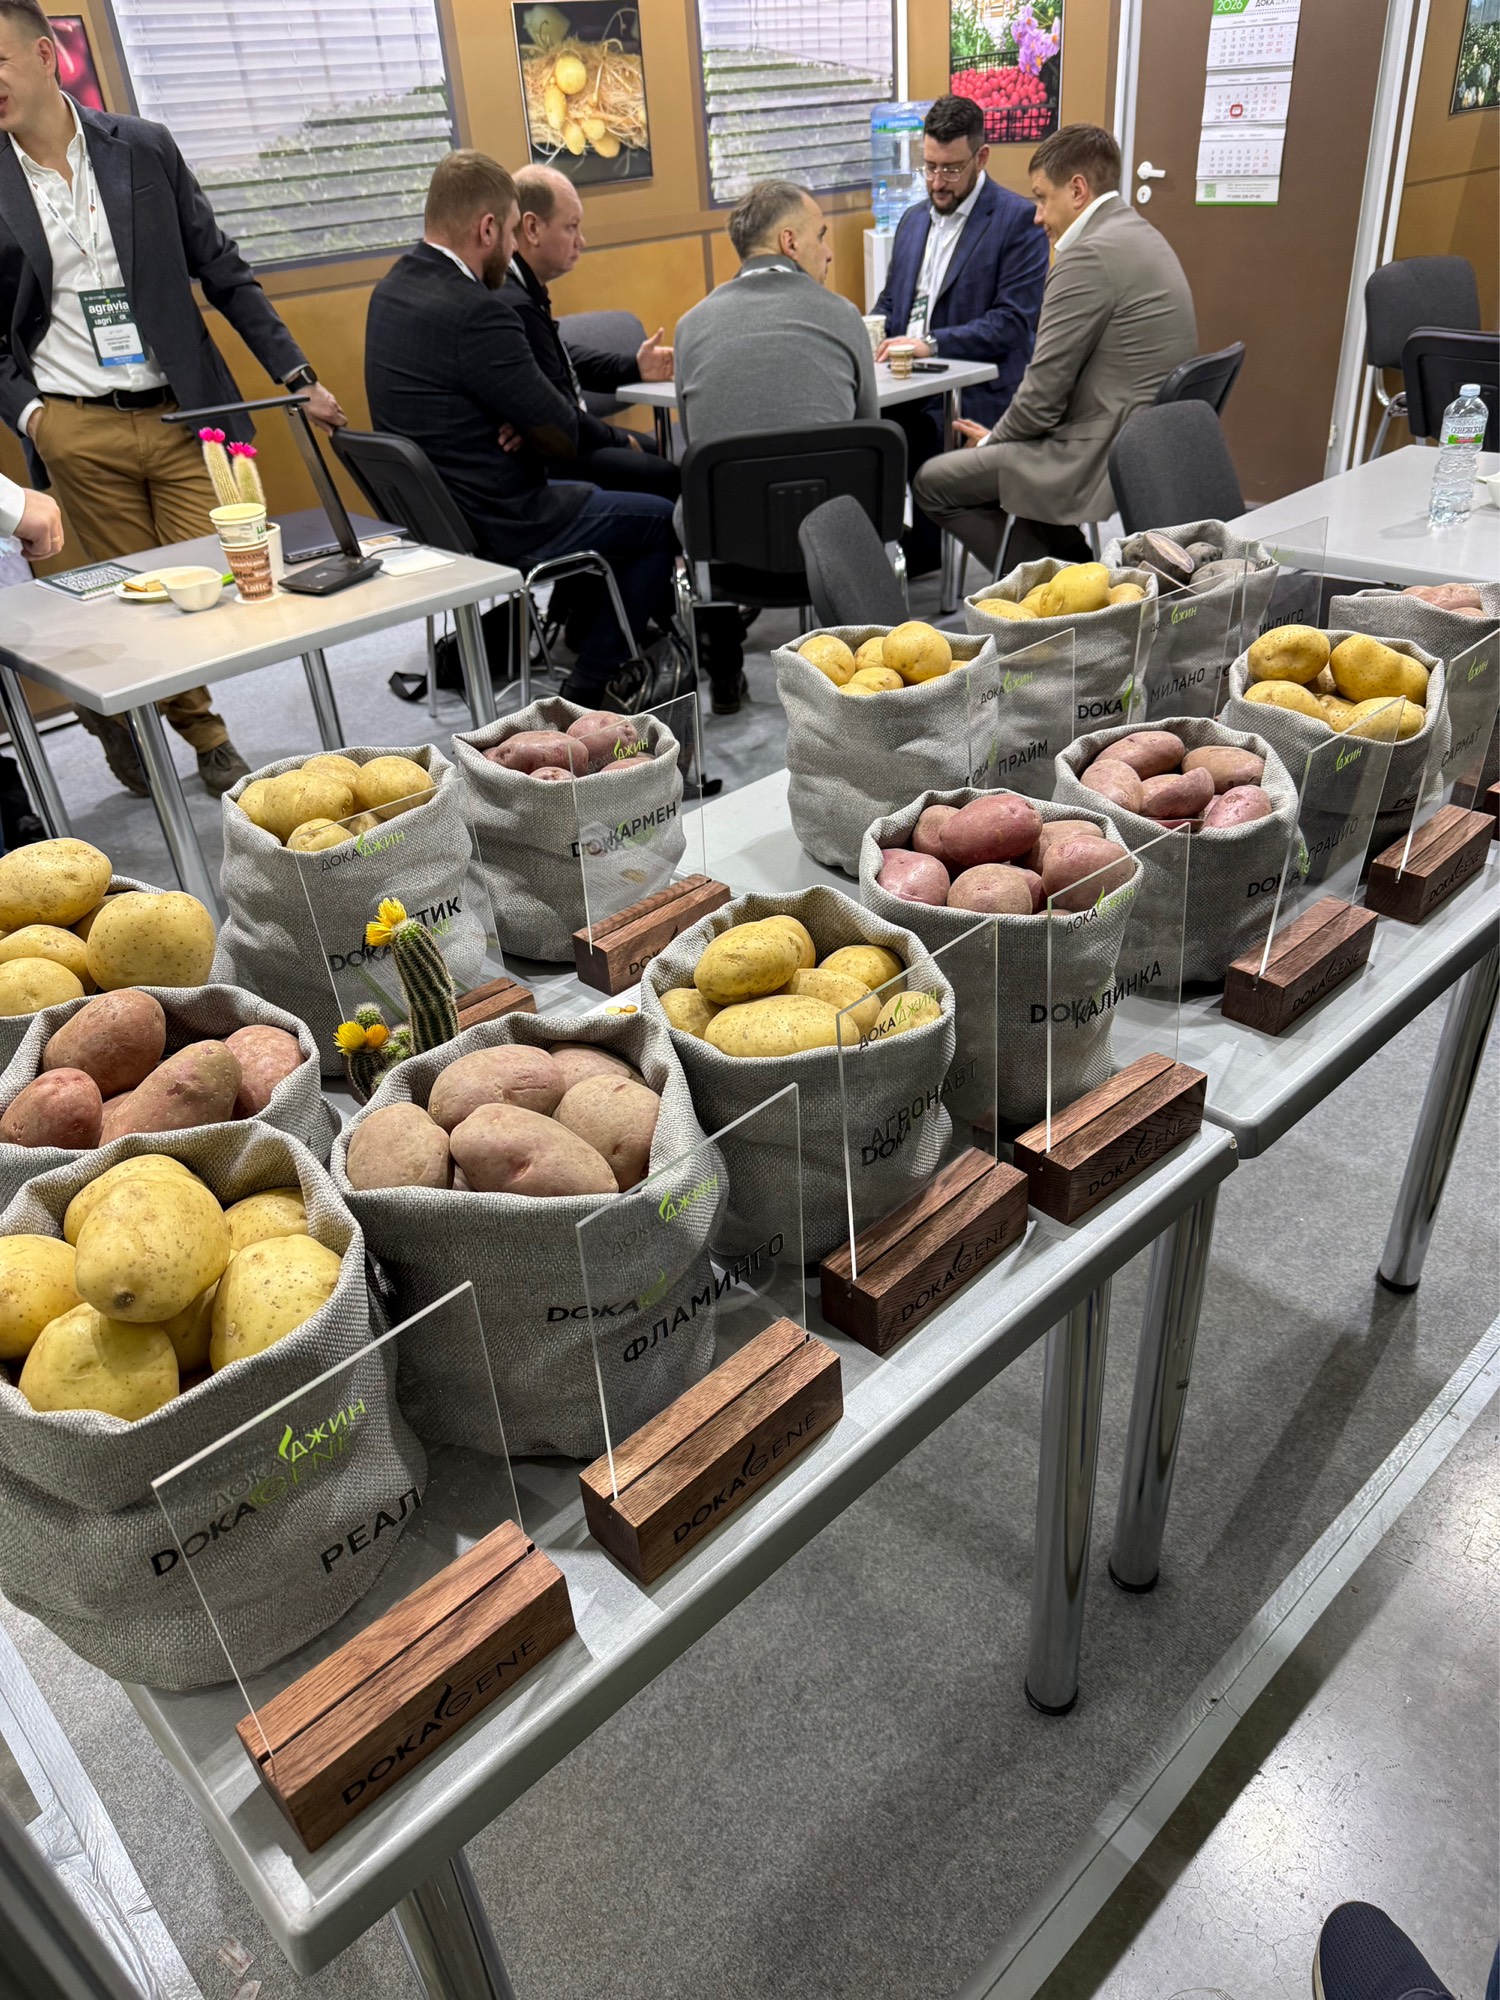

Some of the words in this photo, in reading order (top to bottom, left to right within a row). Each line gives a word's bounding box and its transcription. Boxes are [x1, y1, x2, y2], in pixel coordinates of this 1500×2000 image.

[1217, 0, 1243, 11] 2026
[88, 300, 130, 315] agravia
[1151, 668, 1205, 702] МИЛАНО
[998, 740, 1048, 776] ПРАЙМ
[610, 802, 676, 846] КАРМЕН
[1306, 817, 1358, 865] ГРАЦИО
[871, 1057, 978, 1148] АГРОНАВТ
[623, 1232, 784, 1363] ФЛАМИНГО
[320, 1486, 422, 1574] РЕАЛ
